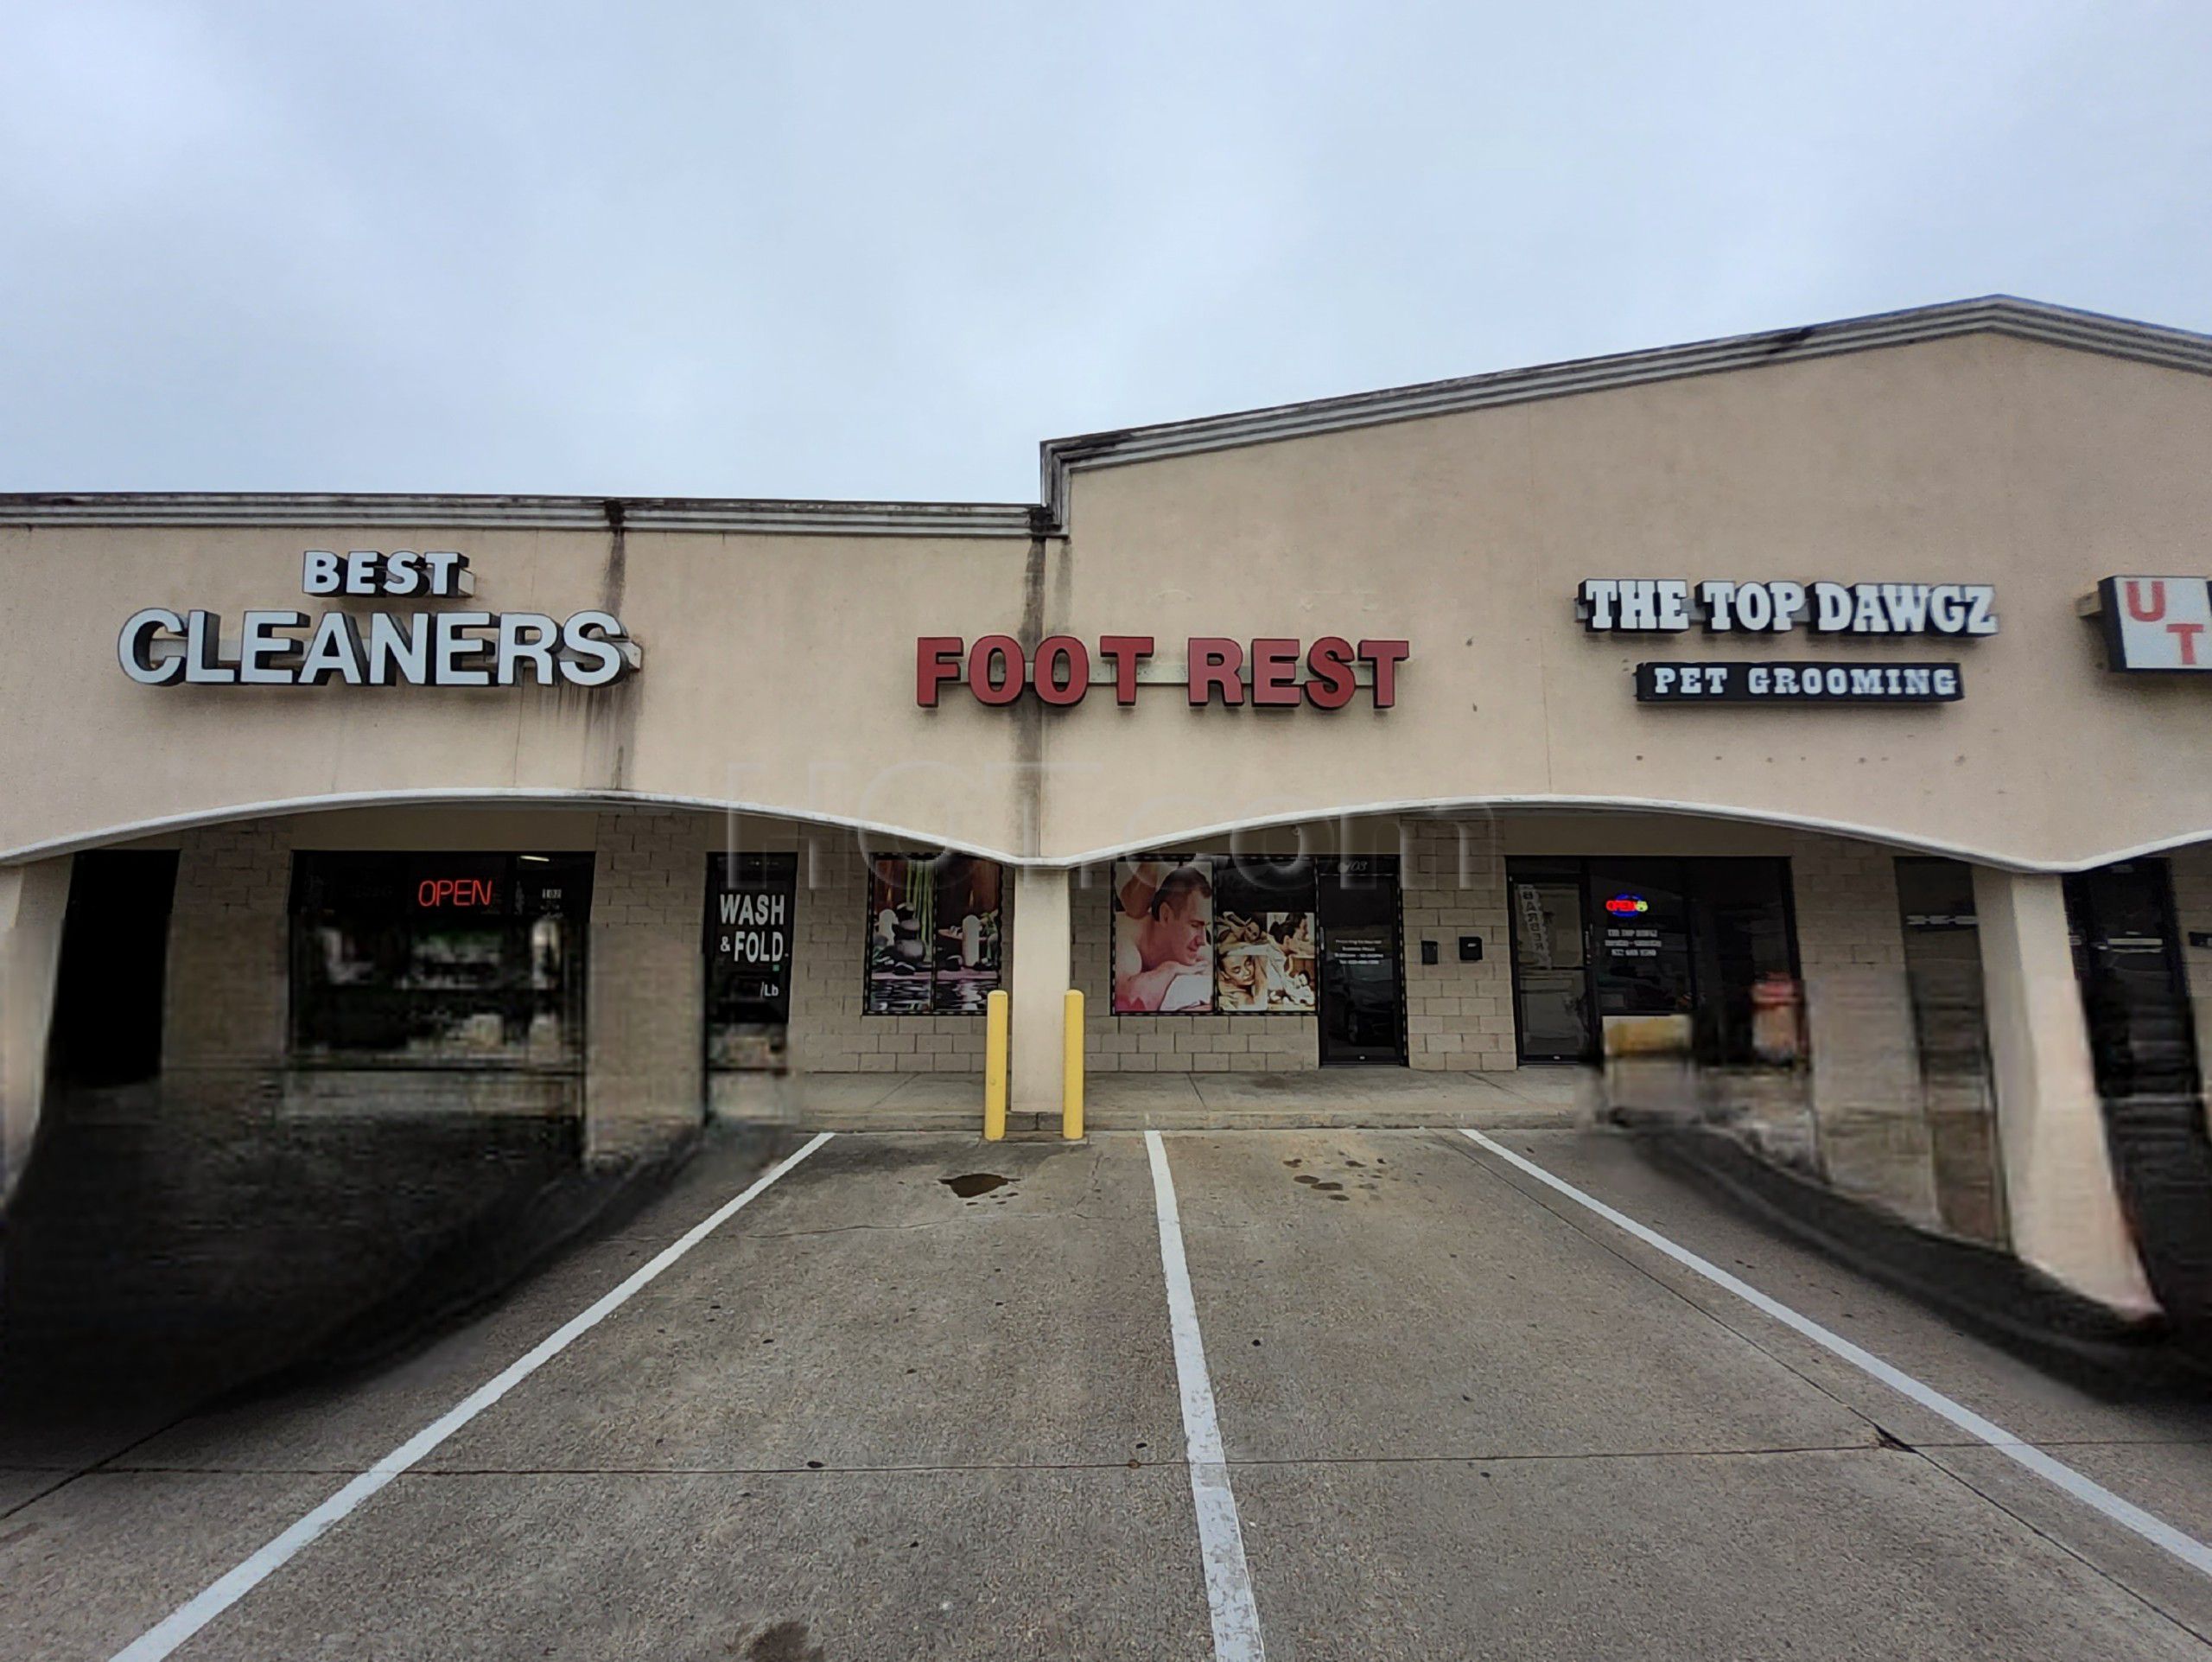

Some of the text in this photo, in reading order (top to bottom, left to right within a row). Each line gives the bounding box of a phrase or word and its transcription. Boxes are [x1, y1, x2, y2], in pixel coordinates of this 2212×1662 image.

[303, 551, 467, 597] BEST
[1580, 579, 1998, 634] THE TOP DAWGZ
[118, 608, 628, 687] CLEANERS
[916, 634, 1410, 709] FOOT REST
[1653, 665, 1958, 695] PET GROOMING
[418, 878, 493, 907] OPEN
[720, 894, 785, 926] WASH
[719, 931, 784, 963] & FOLD
